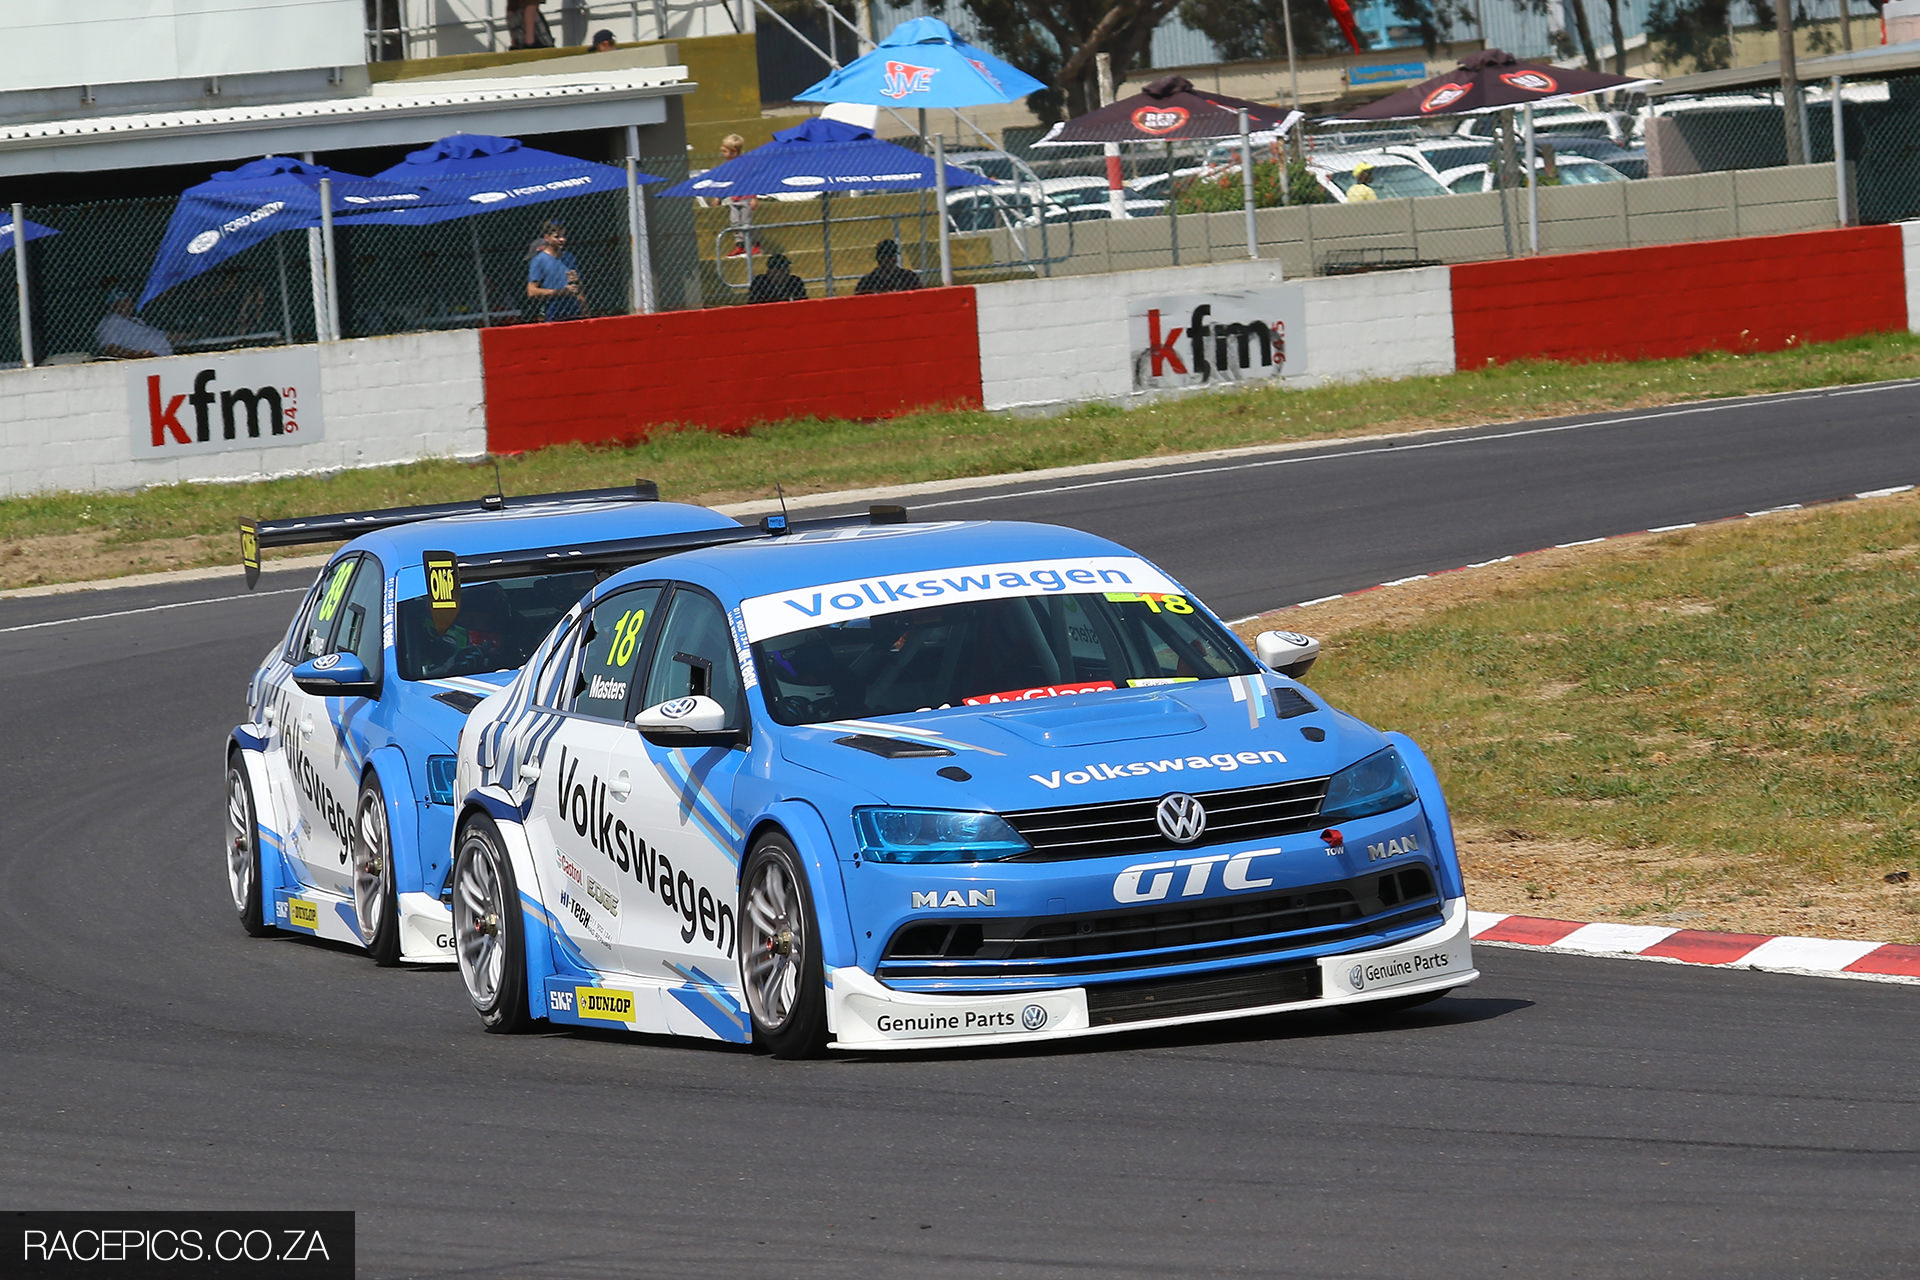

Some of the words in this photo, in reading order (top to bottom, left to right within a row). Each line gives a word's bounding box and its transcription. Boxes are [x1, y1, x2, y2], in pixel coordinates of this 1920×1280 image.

[1148, 304, 1272, 377] kfm
[147, 369, 284, 447] kfm
[283, 386, 299, 434] 94.5
[319, 562, 354, 621] 89
[783, 565, 1134, 618] Volkswagen
[1136, 593, 1195, 615] 18
[606, 609, 646, 667] 18
[588, 674, 627, 700] Masters
[279, 690, 356, 865] Volkswage
[1028, 750, 1288, 790] Volkswagen
[558, 744, 736, 960] Volkswagen
[1324, 847, 1345, 857] TOW
[1367, 834, 1420, 862] MAN
[561, 854, 583, 886] Castrol
[1112, 847, 1282, 904] GTC
[586, 874, 620, 918] EDGE
[911, 889, 996, 909] MAN
[1366, 959, 1412, 981] Genuine
[1414, 953, 1449, 972] Parts
[549, 990, 574, 1011] SKF
[588, 995, 631, 1013] DUNLOP
[877, 1013, 959, 1032] Genuine
[965, 1011, 1015, 1028] Parts
